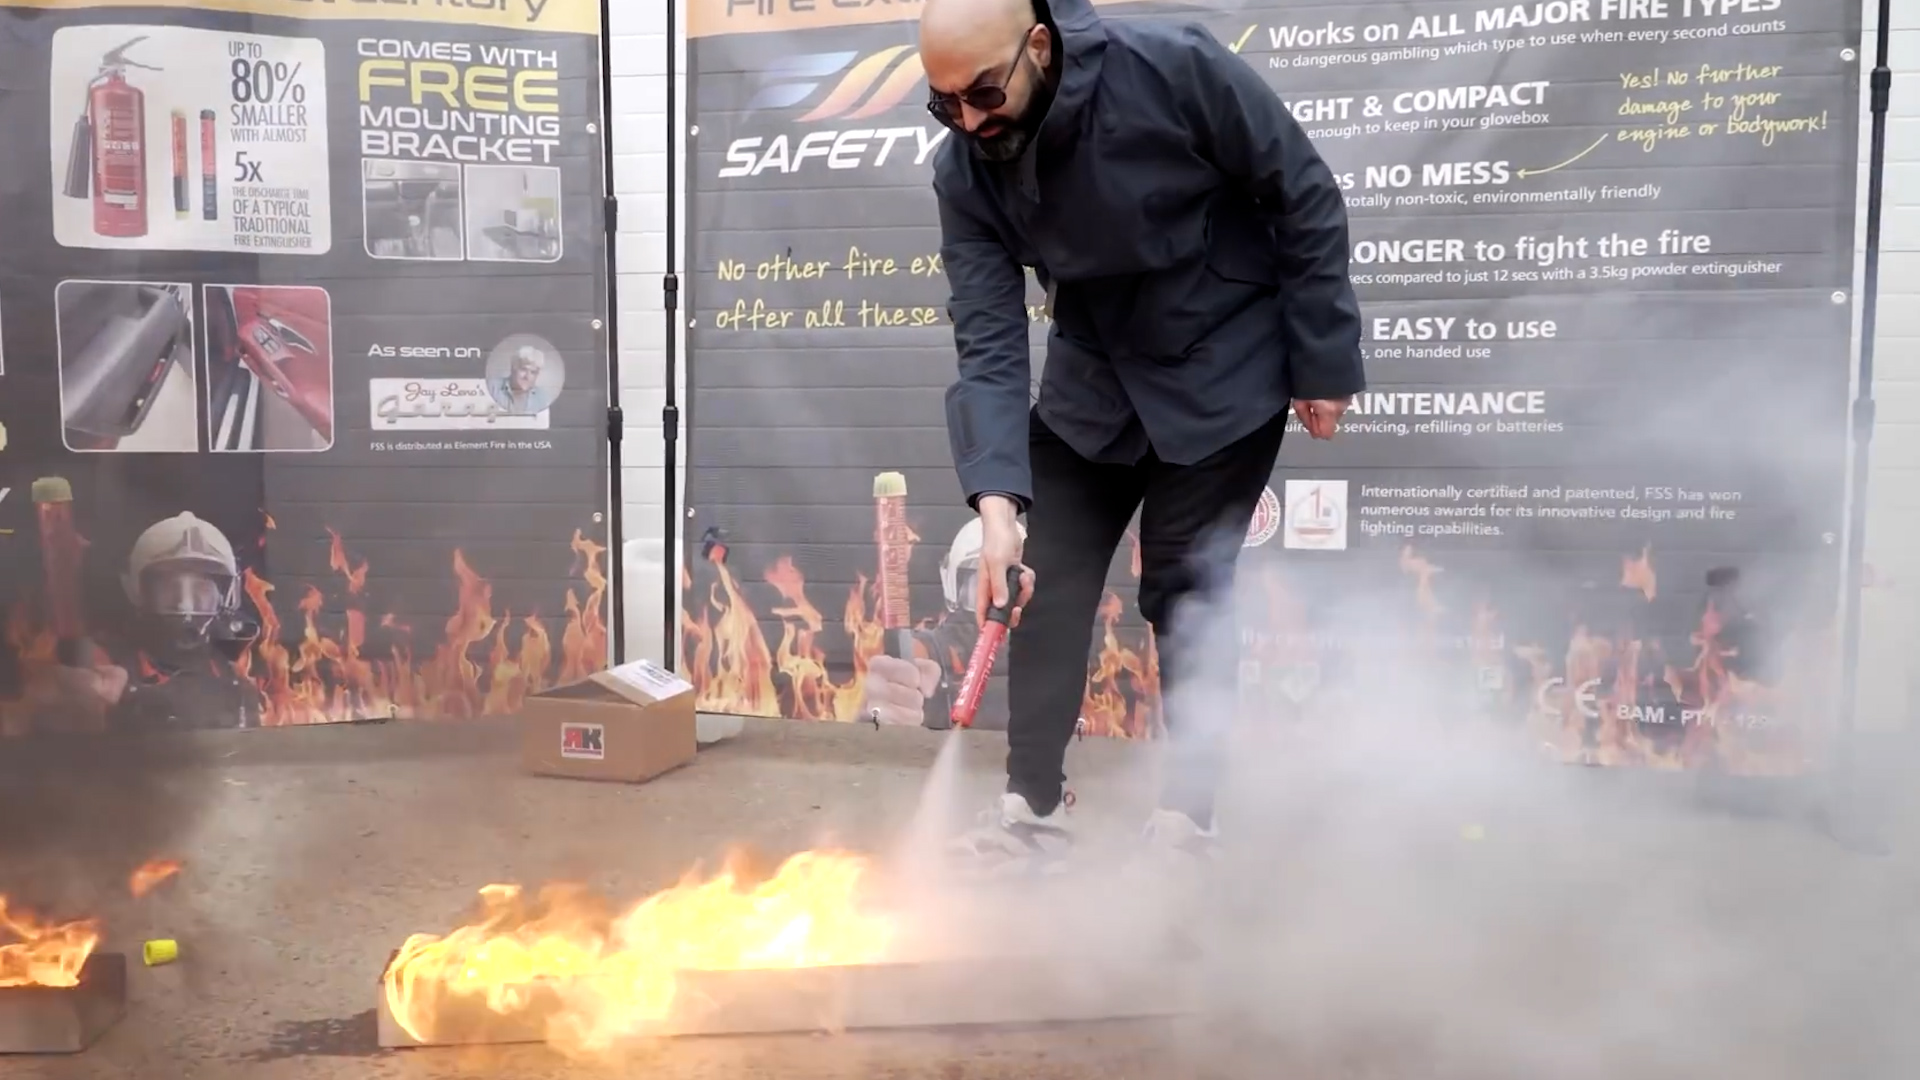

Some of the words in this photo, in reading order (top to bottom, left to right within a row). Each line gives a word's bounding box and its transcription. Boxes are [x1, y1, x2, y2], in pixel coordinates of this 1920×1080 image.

[1268, 21, 1355, 49] Works
[1363, 23, 1399, 42] on
[1408, 14, 1465, 40] ALL
[1475, 1, 1591, 33] MAJOR
[1600, 0, 1668, 21] FIRE
[229, 41, 244, 57] UP
[246, 42, 262, 58] TO
[357, 38, 471, 62] COMES
[480, 45, 557, 68] WITH
[1269, 57, 1288, 69] No
[1292, 50, 1367, 68] dangerous
[1371, 43, 1440, 64] gambling
[1444, 40, 1487, 56] which
[1492, 36, 1525, 52] type
[1529, 34, 1546, 47] to
[1550, 33, 1577, 45] use
[1580, 29, 1624, 43] when
[1627, 27, 1669, 43] every
[1673, 23, 1727, 40] second
[1732, 19, 1786, 35] counts
[231, 58, 305, 104] 80%
[359, 60, 559, 112] FREE
[1620, 68, 1659, 89] Yes!
[1667, 71, 1688, 86] No
[1696, 63, 1783, 86] further
[1284, 97, 1354, 122] GHT
[1362, 96, 1383, 117] &
[1392, 81, 1550, 114] COMPACT
[1618, 97, 1693, 124] damage
[1702, 94, 1724, 110] to
[1731, 92, 1781, 121] your
[231, 104, 307, 126] SMALLER
[360, 105, 560, 136] MOUNTING
[1307, 124, 1360, 139] enough
[1366, 124, 1380, 133] to
[1385, 119, 1419, 133] keep
[1424, 116, 1438, 129] in
[1441, 116, 1476, 131] your
[1480, 110, 1549, 129] glovebox
[231, 128, 259, 142] WITH
[263, 128, 307, 142] ALMOST
[1617, 122, 1690, 152] engine
[1699, 122, 1718, 135] or
[1727, 111, 1827, 146] bodywork!
[361, 130, 560, 163] BRACKET
[718, 127, 950, 178] SAFETY
[234, 151, 263, 182] 5x
[1365, 164, 1412, 188] NO
[1422, 160, 1510, 187] MESS
[233, 199, 249, 214] OF
[252, 201, 260, 215] A
[264, 200, 311, 217] TYPICAL
[1345, 192, 1391, 209] totally
[1395, 190, 1468, 206] non-toxic,
[1473, 186, 1596, 204] environmentally
[1600, 184, 1661, 199] friendly
[234, 216, 311, 234] TRADITIONAL
[1349, 239, 1464, 264] ONGER
[1475, 239, 1505, 262] to
[1515, 235, 1589, 266] fight
[1597, 233, 1648, 258] the
[1658, 229, 1711, 255] fire
[718, 259, 745, 281] No
[757, 255, 830, 282] other
[843, 246, 898, 280] fire
[1376, 270, 1443, 286] compared
[1446, 272, 1461, 283] to
[1464, 270, 1489, 286] just
[1494, 270, 1509, 282] 12
[1512, 271, 1539, 282] secs
[1542, 268, 1573, 281] with
[1577, 270, 1586, 280] a
[1589, 265, 1628, 283] 3.5kg
[1632, 262, 1687, 283] powder
[1691, 260, 1782, 278] extinguisher
[716, 299, 793, 331] offer
[805, 300, 845, 327] all
[858, 300, 939, 328] these
[1373, 317, 1456, 341] EASY
[1465, 318, 1497, 340] to
[1507, 320, 1557, 340] use
[368, 344, 395, 357] As
[400, 346, 450, 358] seen
[454, 346, 481, 358] on
[1374, 348, 1401, 359] one
[1406, 345, 1461, 359] handed
[1466, 347, 1491, 359] use
[1343, 391, 1545, 416] AINTENANCE
[1344, 421, 1410, 436] servicing,
[1414, 419, 1472, 436] refilling
[1476, 422, 1491, 433] or
[1496, 420, 1563, 433] batteries
[395, 442, 442, 450] distributed
[454, 441, 488, 450] Element
[490, 441, 506, 450] Fire
[508, 441, 516, 449] in
[518, 441, 532, 449] the
[534, 441, 551, 449] USA
[1361, 484, 1462, 501] Internationally
[1467, 485, 1528, 499] certified
[1532, 485, 1561, 498] and
[1565, 485, 1639, 502] patented,
[1645, 487, 1673, 500] FSS
[1678, 487, 1704, 501] has
[1709, 491, 1741, 501] won
[1361, 505, 1429, 516] numerous
[1434, 504, 1486, 517] awards
[1490, 504, 1511, 517] for
[1515, 504, 1533, 517] its
[1538, 504, 1616, 518] innovative
[1620, 504, 1671, 522] design
[1675, 504, 1704, 519] and
[1709, 506, 1736, 519] fire
[1360, 520, 1414, 537] fighting
[1418, 520, 1504, 537] capabilities.
[1616, 704, 1664, 724] BAM
